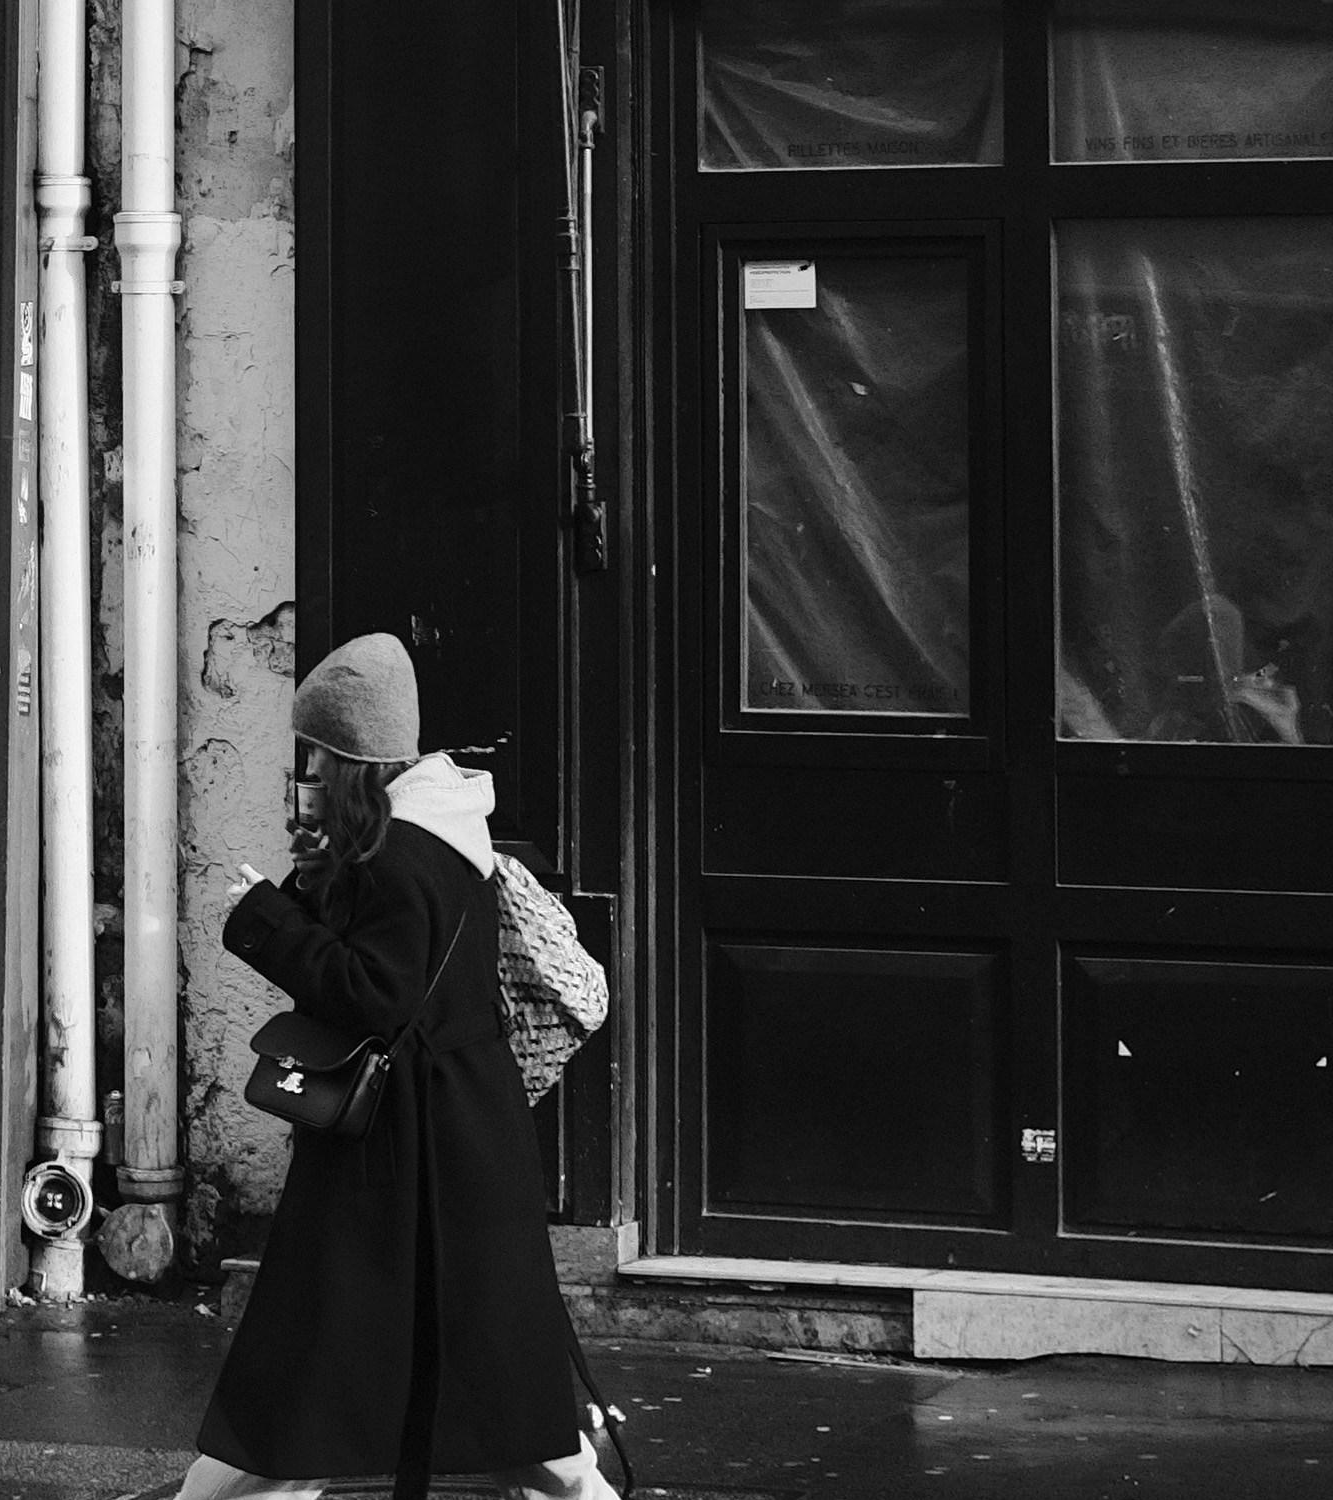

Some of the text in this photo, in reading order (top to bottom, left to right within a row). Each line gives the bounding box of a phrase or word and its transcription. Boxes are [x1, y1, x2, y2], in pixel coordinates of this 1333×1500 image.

[787, 140, 919, 157] RILLETTES MAISON
[1085, 136, 1116, 151] VINS
[1123, 135, 1154, 150] FINS
[1162, 134, 1180, 149] ET
[759, 681, 795, 697] CHEZ
[864, 683, 900, 699] C'EST
